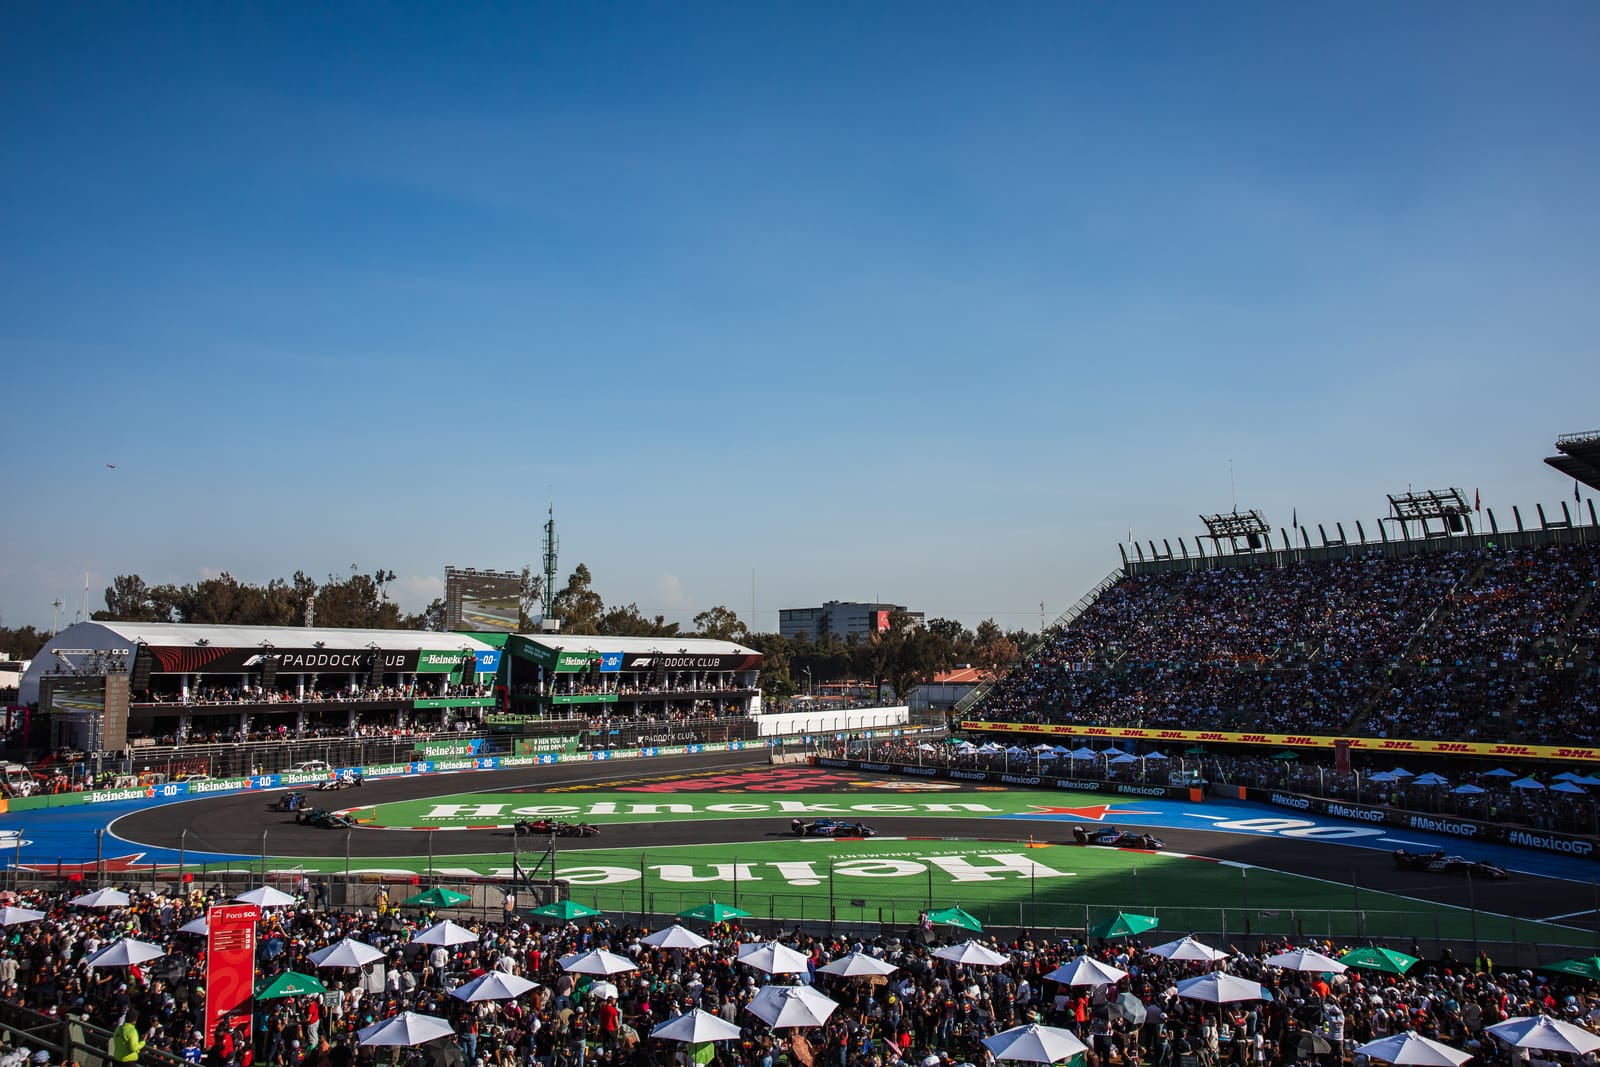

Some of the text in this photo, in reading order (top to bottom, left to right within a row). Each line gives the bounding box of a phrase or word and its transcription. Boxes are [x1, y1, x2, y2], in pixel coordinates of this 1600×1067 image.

[282, 654, 362, 666] PADDOCK
[367, 656, 406, 666] CUB
[428, 654, 466, 664] Heinek
[652, 658, 696, 667] PDDOCK
[697, 658, 720, 667] CLUB
[1383, 741, 1414, 749] DHL
[1438, 743, 1470, 752] DHL
[1495, 746, 1530, 755] DHL
[1558, 749, 1595, 758] DHL
[440, 761, 472, 770] Heineken
[504, 756, 532, 766] Heineken
[369, 764, 403, 776] Heineken
[289, 772, 328, 783] Heineken
[1001, 775, 1040, 785] #MexicoGP
[198, 780, 241, 792] Heineken
[1057, 780, 1099, 790] #MexicoGP
[1118, 785, 1165, 796] #MexicoGP
[93, 789, 143, 802] Heineken
[1272, 793, 1309, 809] #MexicoGP
[420, 800, 1004, 818] Heineken
[1328, 804, 1384, 823] #MexicoGP
[1410, 815, 1477, 837] #MexicoGP
[1509, 831, 1592, 855] #MexicoGP
